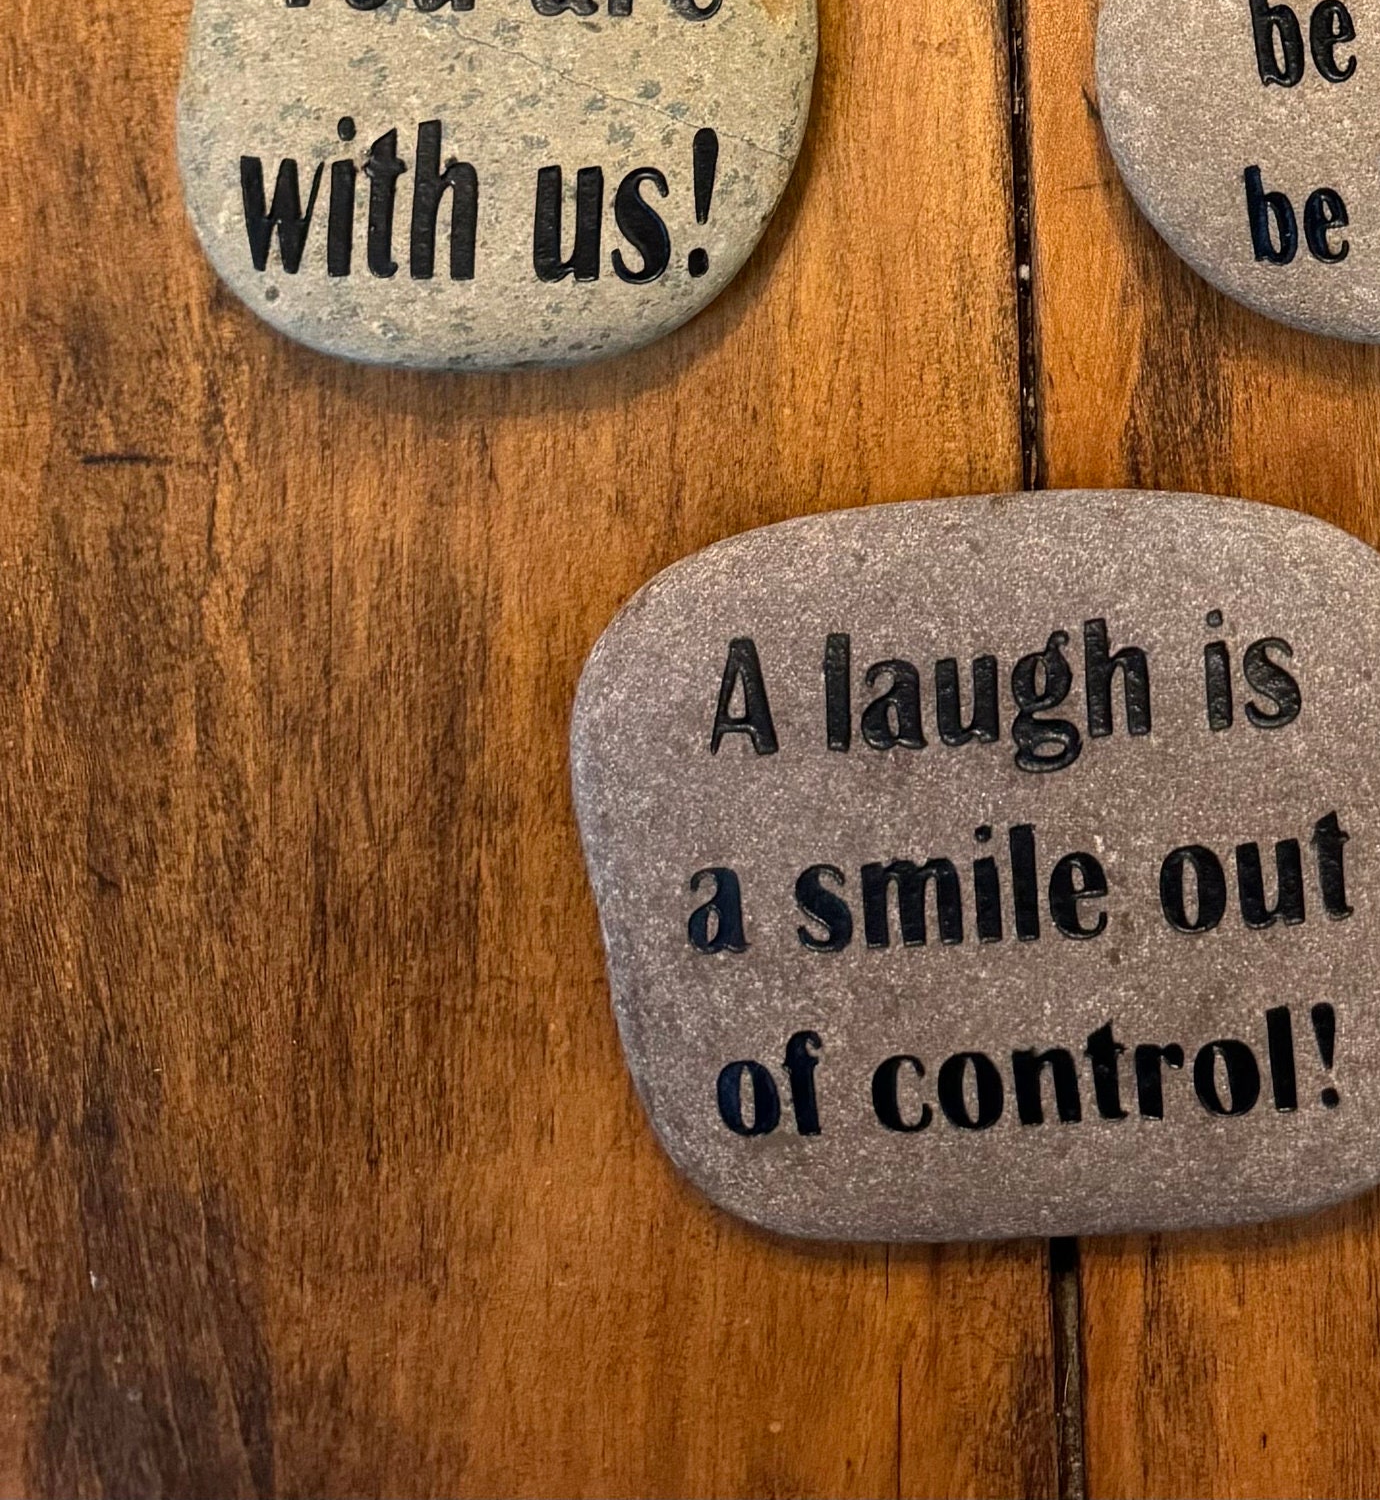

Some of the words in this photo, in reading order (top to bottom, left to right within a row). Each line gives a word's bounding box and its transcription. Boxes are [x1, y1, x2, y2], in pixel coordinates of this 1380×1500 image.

[240, 116, 479, 281] with
[533, 128, 719, 285] us!
[1242, 165, 1349, 267] be
[710, 637, 779, 757] A
[822, 618, 1152, 775] laugh
[1204, 609, 1302, 734] is
[687, 867, 751, 955] a
[795, 824, 1108, 954] smile
[1159, 810, 1354, 933] out
[717, 1030, 822, 1138] of
[872, 1003, 1340, 1135] control!
